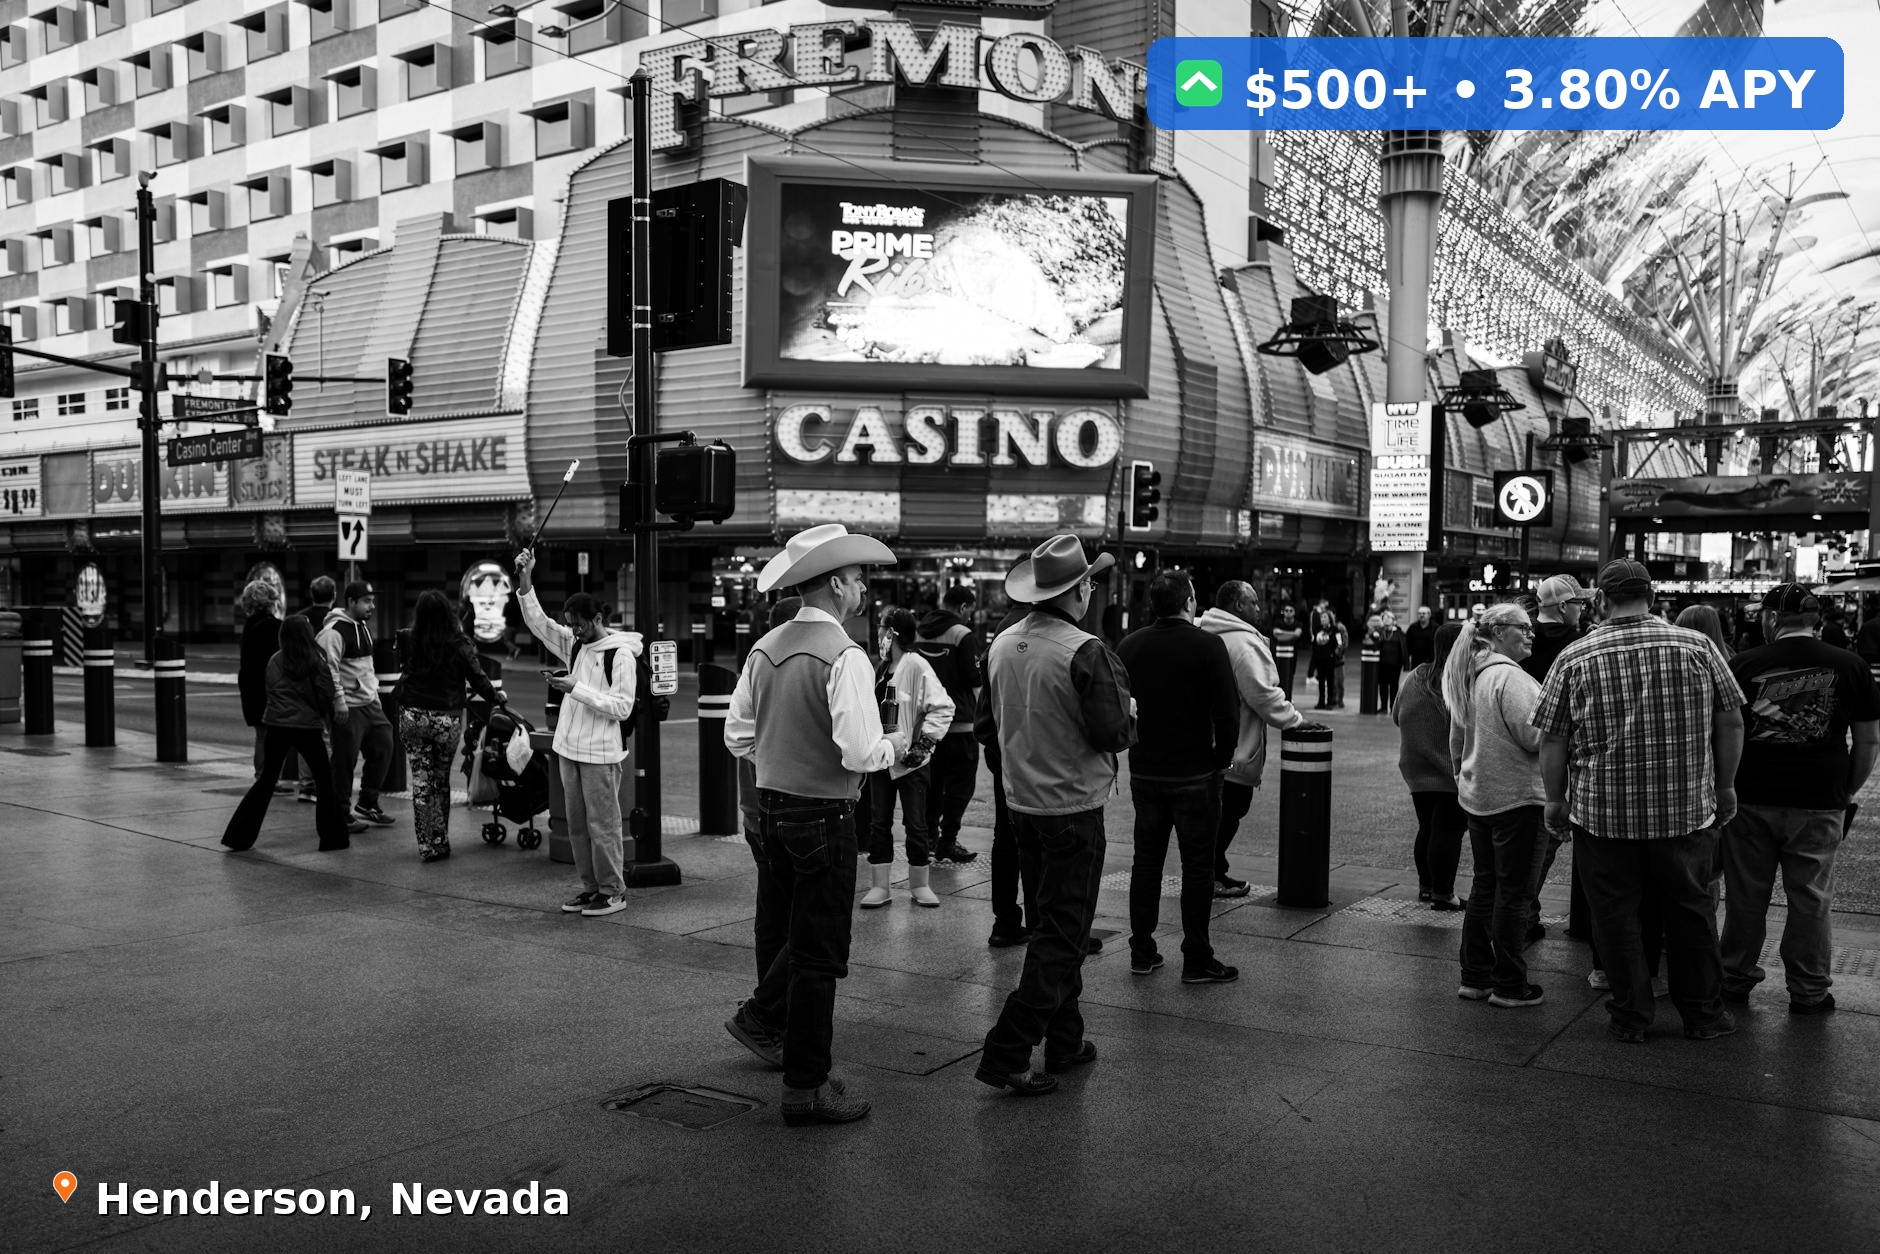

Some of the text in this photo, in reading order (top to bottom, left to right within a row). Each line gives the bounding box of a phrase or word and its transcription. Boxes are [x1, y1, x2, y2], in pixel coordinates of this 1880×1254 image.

[831, 230, 935, 259] PRIME
[837, 247, 926, 299] Rib
[184, 399, 225, 410] FREMONT
[175, 440, 208, 460] Casino
[209, 436, 242, 456] Center
[775, 403, 1122, 469] CASINO
[313, 446, 392, 481] STEAK
[415, 436, 507, 475] SHAKE
[1377, 455, 1426, 470] BUSH
[343, 487, 364, 496] MUST
